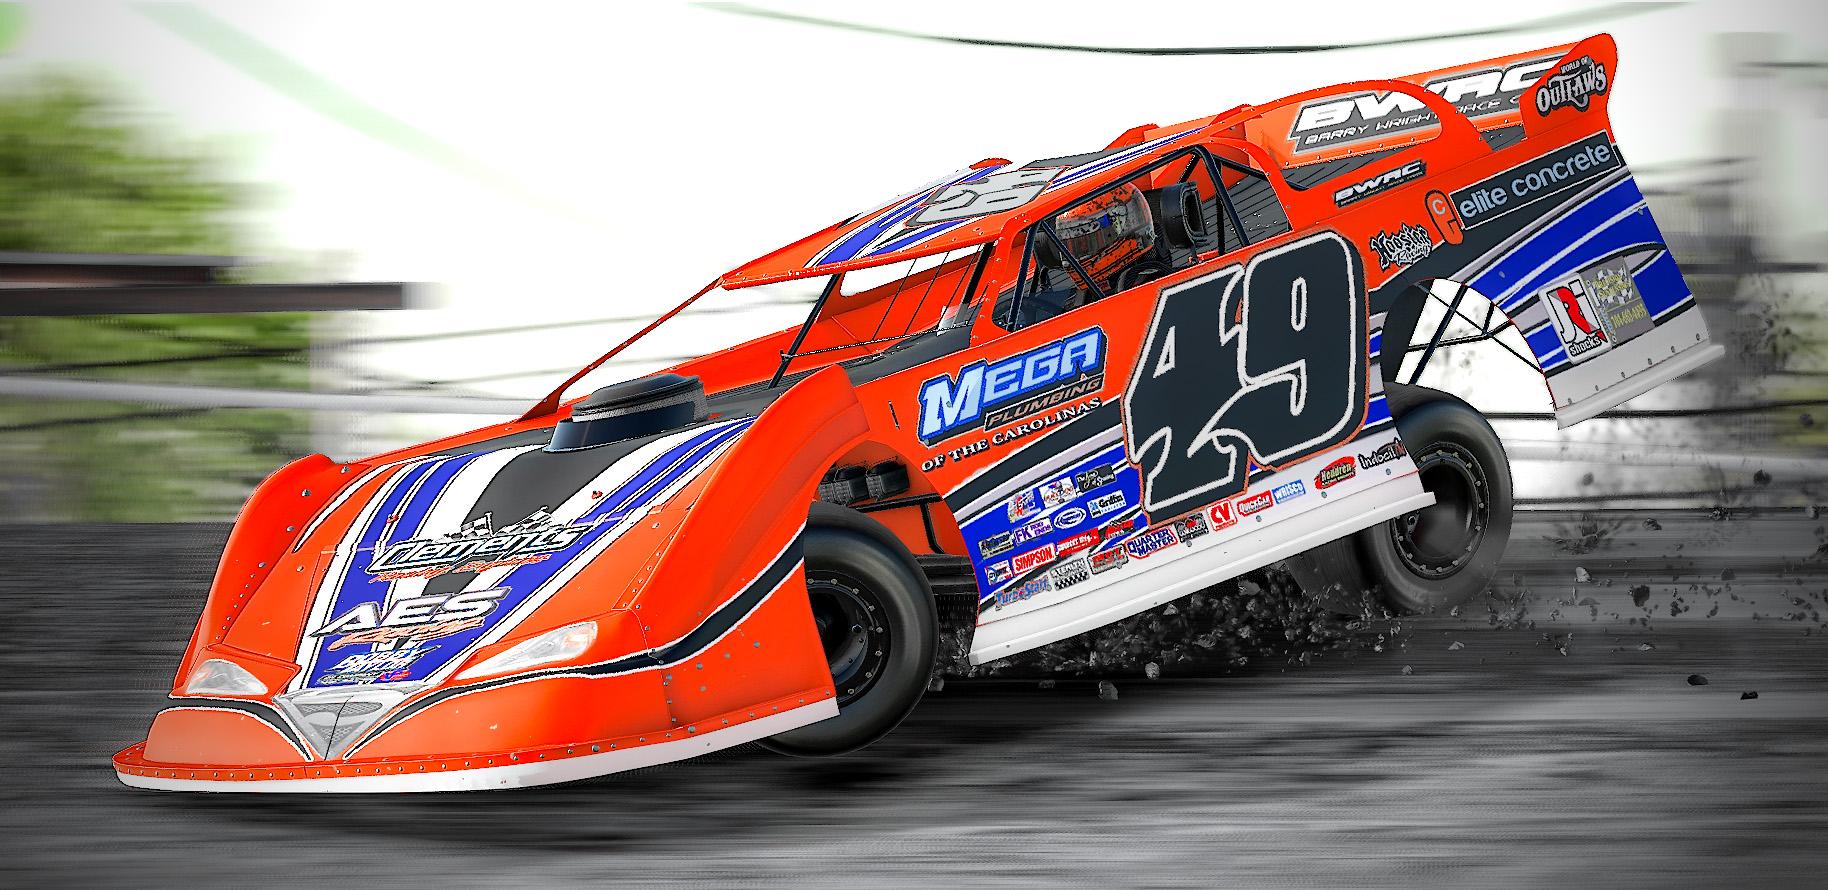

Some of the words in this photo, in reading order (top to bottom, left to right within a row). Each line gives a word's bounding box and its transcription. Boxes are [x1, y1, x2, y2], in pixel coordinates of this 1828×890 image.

[1559, 60, 1580, 75] WORLD
[1537, 64, 1607, 113] OUTLAWS
[1304, 124, 1369, 145] BARRY
[1375, 109, 1438, 132] WRIGH
[1459, 186, 1508, 218] elite
[1511, 144, 1611, 196] concrete
[1568, 335, 1601, 357] shocks
[919, 327, 1104, 438] MEGA
[1122, 229, 1366, 520] 49
[988, 378, 1101, 428] PLUMBING
[921, 455, 945, 472] OF
[948, 437, 989, 461] THE
[992, 396, 1101, 446] CAROLINAS
[1209, 504, 1231, 525] CV
[1014, 525, 1033, 543] FK
[1127, 529, 1170, 554] QUARTER
[1136, 534, 1175, 556] MASTER
[1014, 547, 1054, 571] SIMPSON
[310, 586, 512, 638] AES
